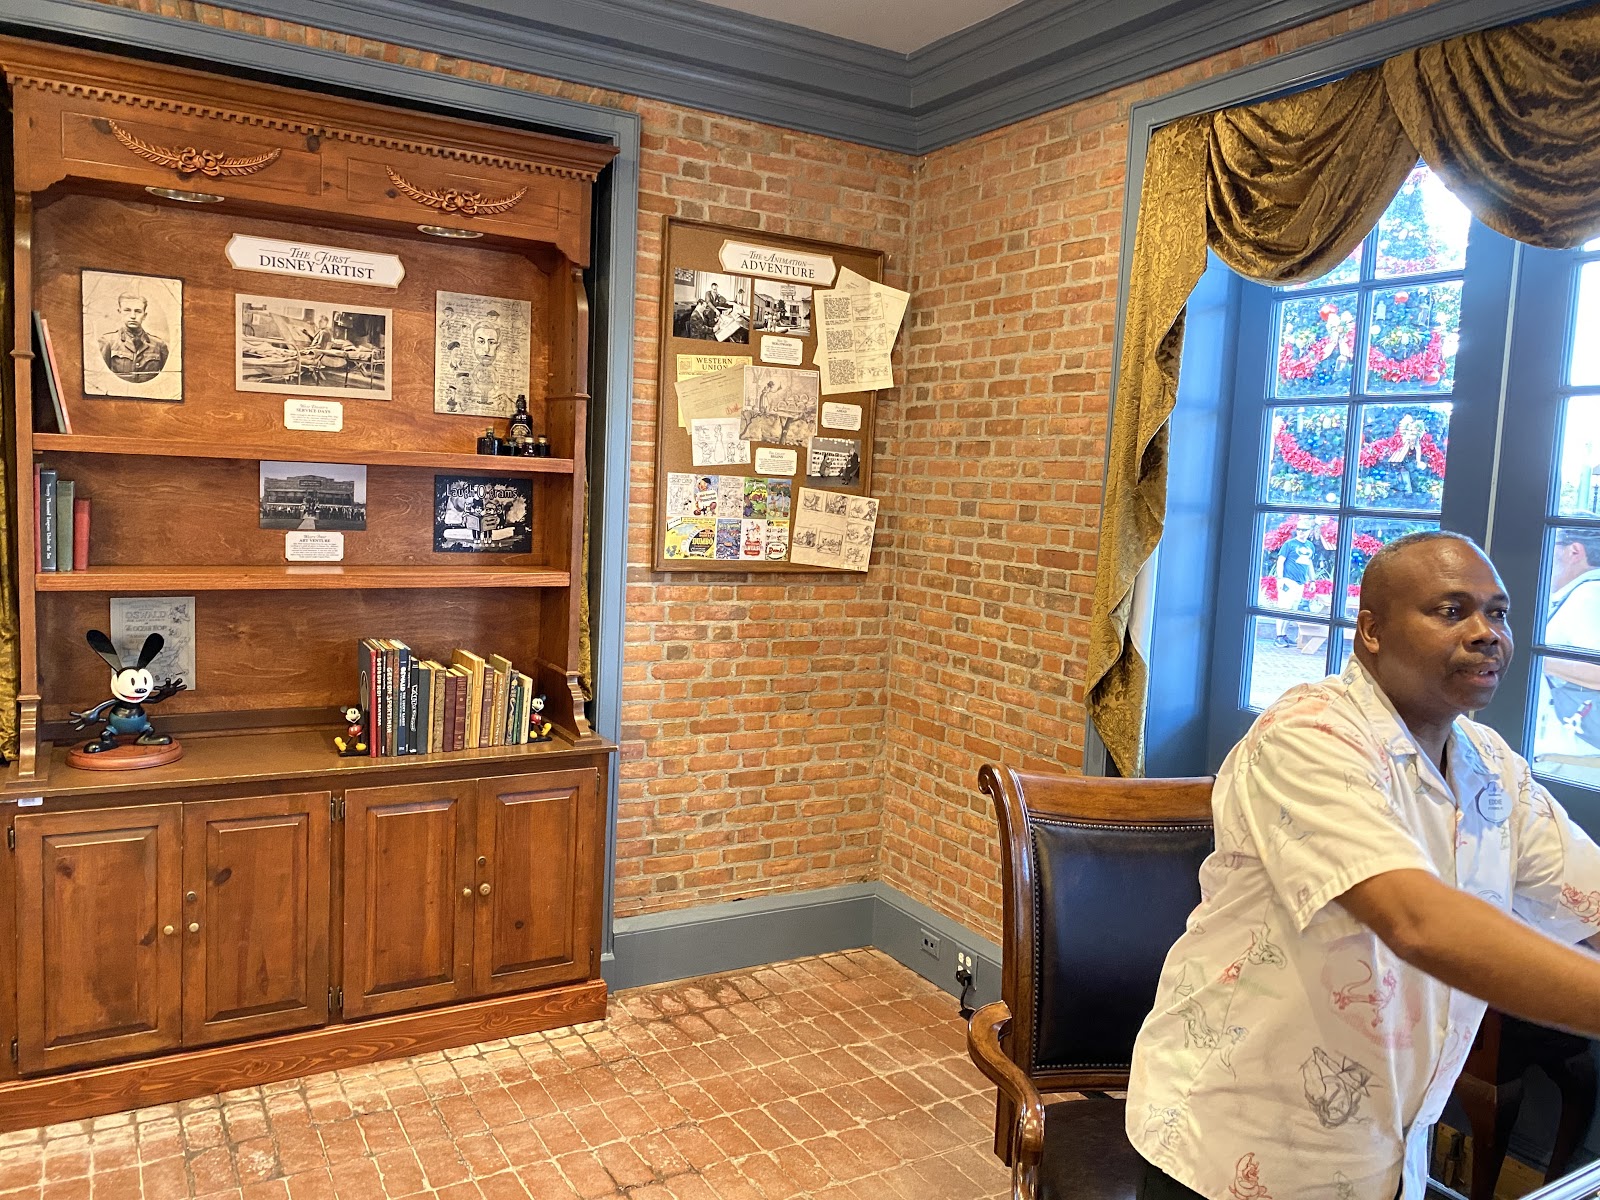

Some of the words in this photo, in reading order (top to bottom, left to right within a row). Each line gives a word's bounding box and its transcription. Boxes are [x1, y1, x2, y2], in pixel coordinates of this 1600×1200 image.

[259, 254, 315, 272] DISNEY
[320, 261, 375, 279] ARTIST
[764, 253, 808, 267] ANIMATION
[740, 260, 815, 279] ADVENTURE
[696, 357, 733, 365] WESTERN
